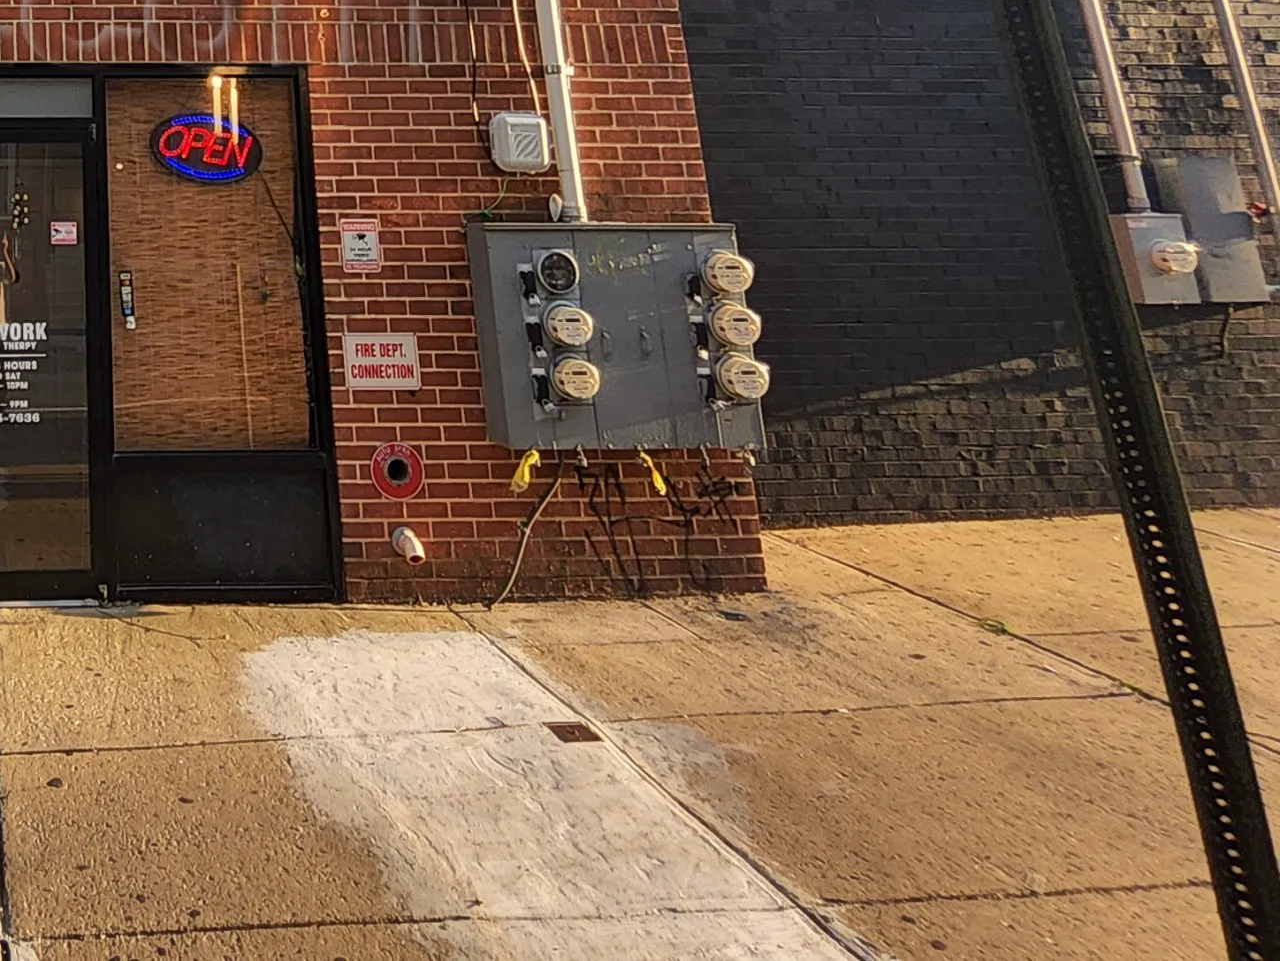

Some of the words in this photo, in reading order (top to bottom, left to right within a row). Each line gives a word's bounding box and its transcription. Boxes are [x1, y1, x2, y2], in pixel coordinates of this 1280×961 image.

[158, 125, 253, 169] OPEN
[3, 341, 37, 351] THERPY
[355, 343, 377, 358] FIRE
[379, 343, 407, 358] DEPT.
[4, 360, 37, 370] HOURS
[5, 372, 21, 380] SAT
[351, 364, 415, 379] CONNECTION
[9, 400, 28, 408] 9PM
